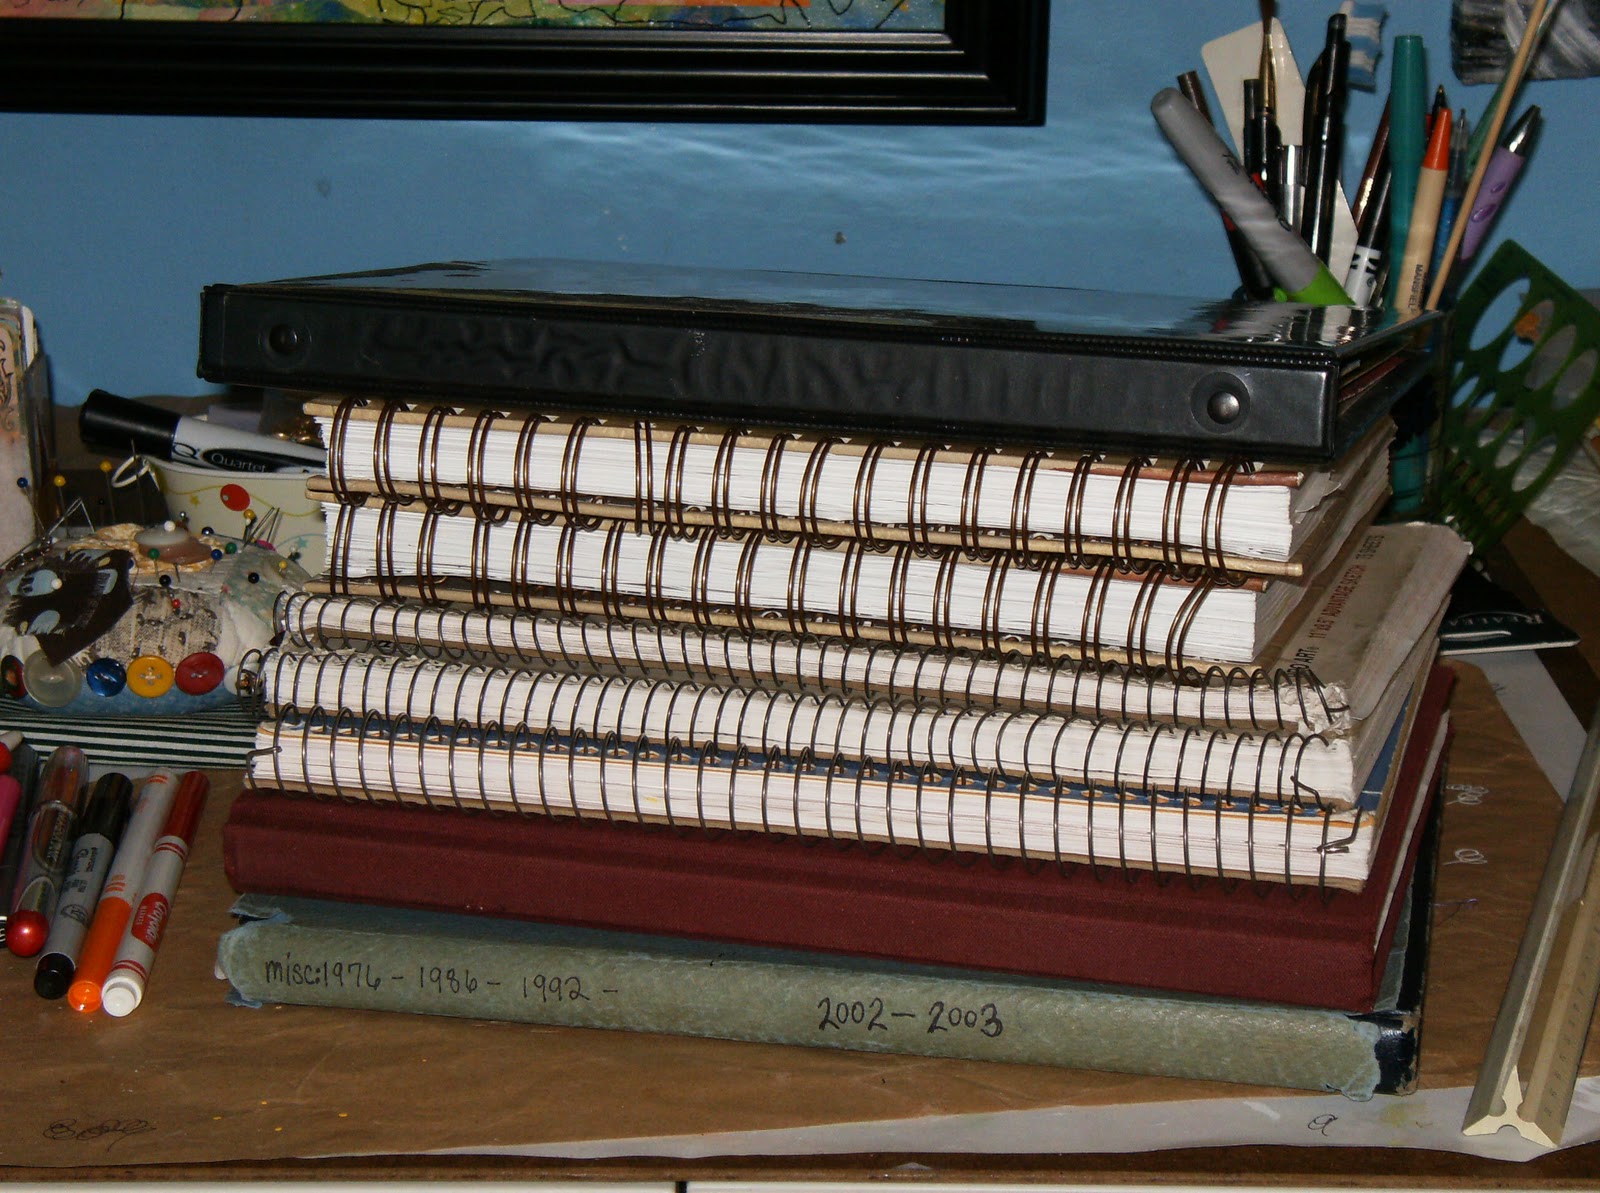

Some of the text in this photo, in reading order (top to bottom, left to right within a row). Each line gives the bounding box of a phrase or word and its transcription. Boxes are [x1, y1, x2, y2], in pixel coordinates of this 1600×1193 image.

[211, 452, 267, 473] Quartet
[145, 901, 168, 943] Crayola
[419, 966, 479, 995] 1986
[522, 976, 591, 1002] 1992
[817, 997, 888, 1031] 2002
[927, 1001, 1003, 1037] 2003
